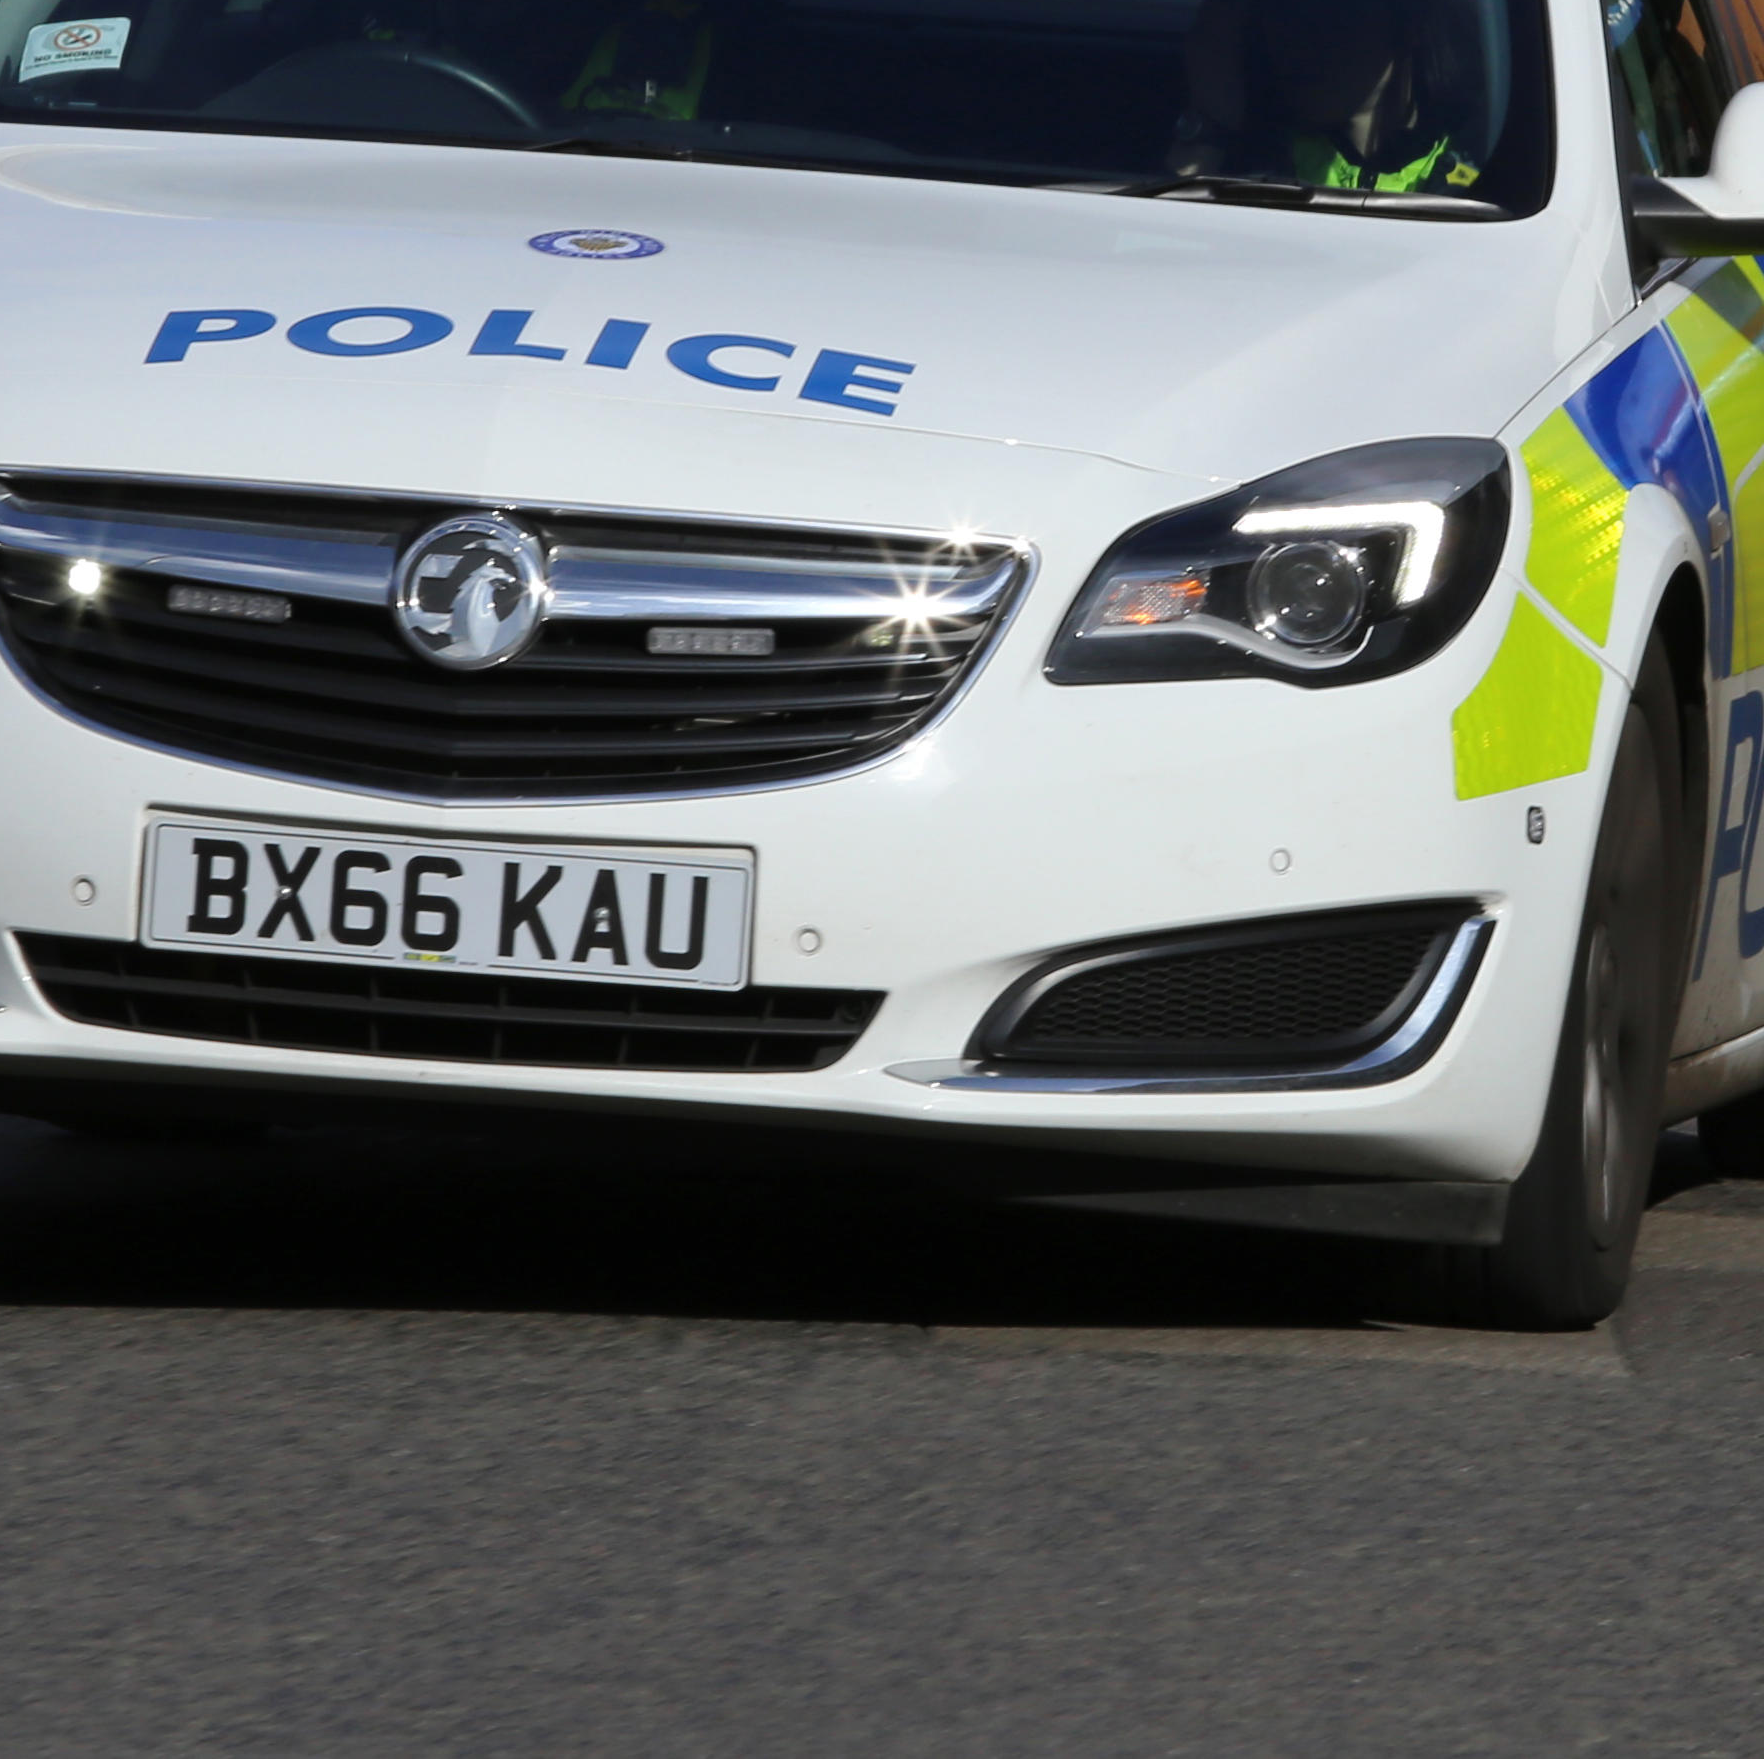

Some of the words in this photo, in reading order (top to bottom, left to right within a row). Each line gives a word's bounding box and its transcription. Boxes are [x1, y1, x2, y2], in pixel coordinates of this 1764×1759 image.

[34, 54, 52, 62] NO
[144, 306, 917, 417] POLICE
[187, 837, 463, 952] BX66
[498, 862, 709, 971] KAU
